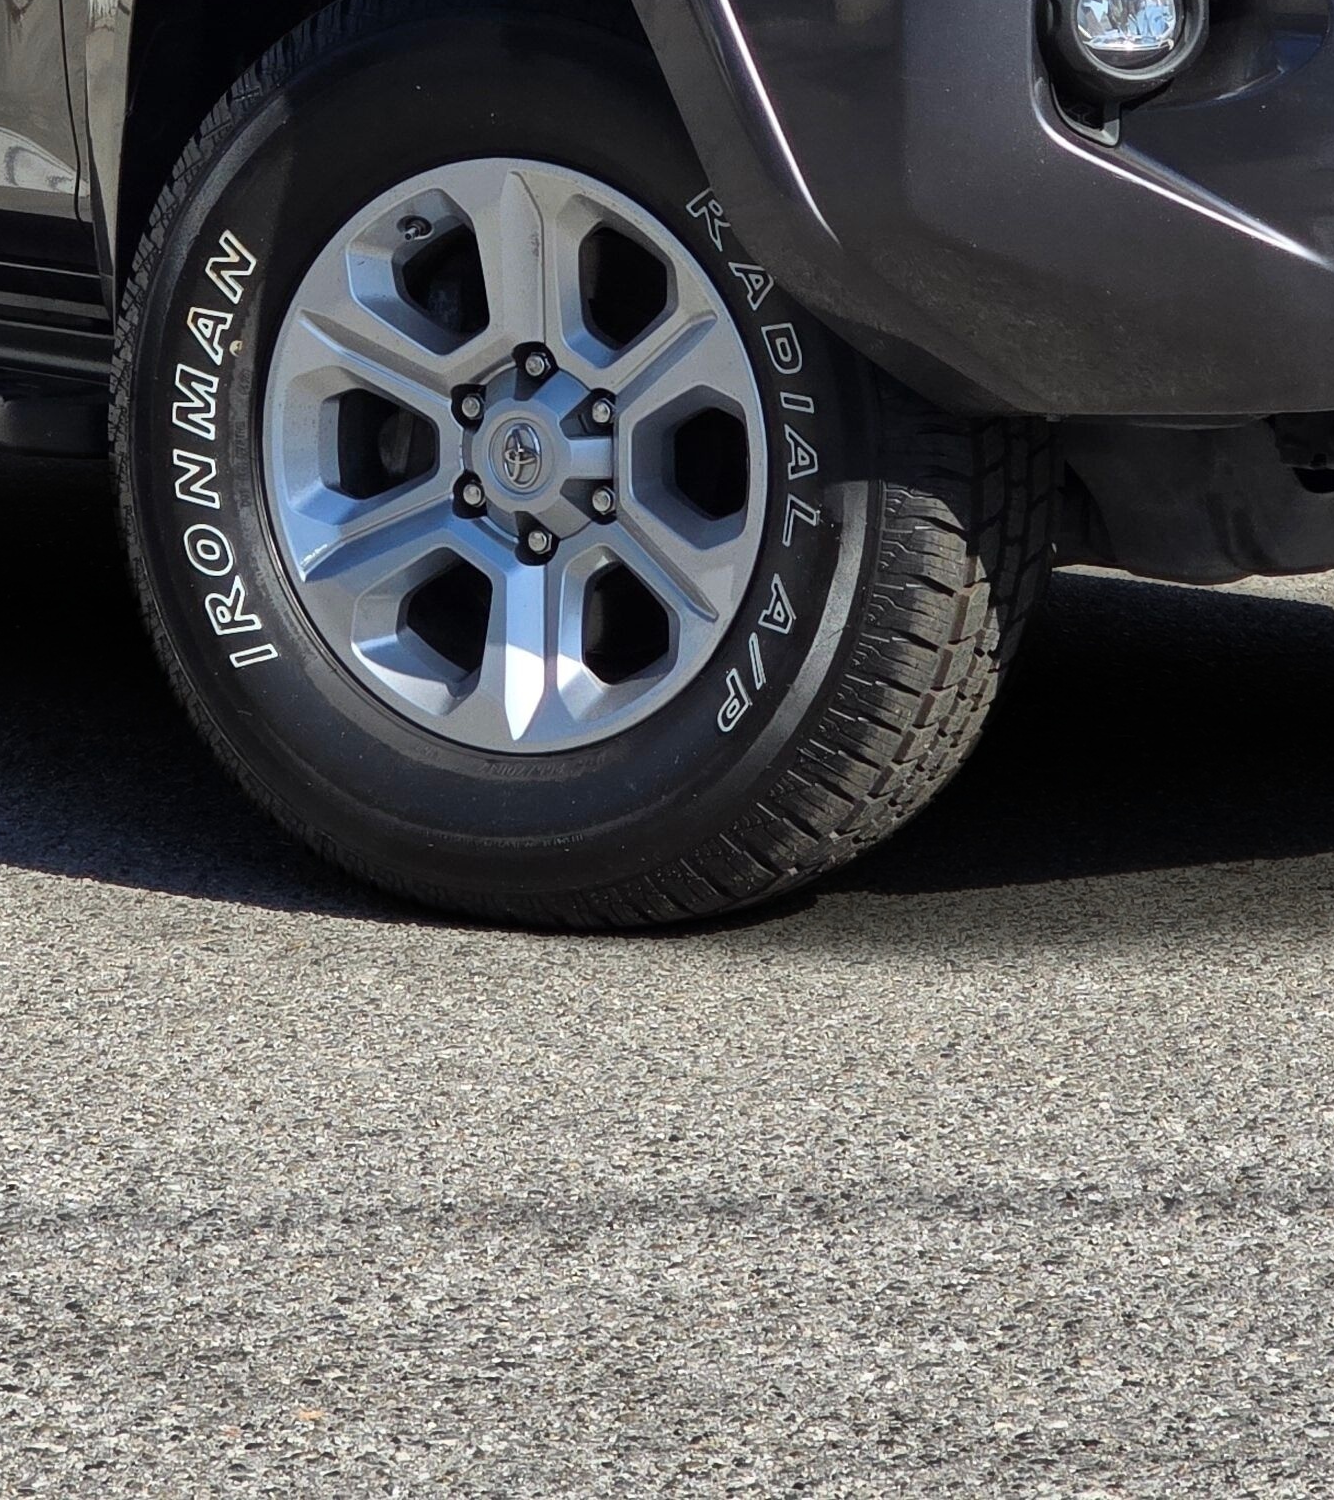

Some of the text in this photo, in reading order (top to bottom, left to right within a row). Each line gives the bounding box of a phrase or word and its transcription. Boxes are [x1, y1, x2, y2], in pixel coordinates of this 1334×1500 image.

[173, 229, 278, 668] IRONMAN
[685, 187, 821, 733] RADIAL A/P
